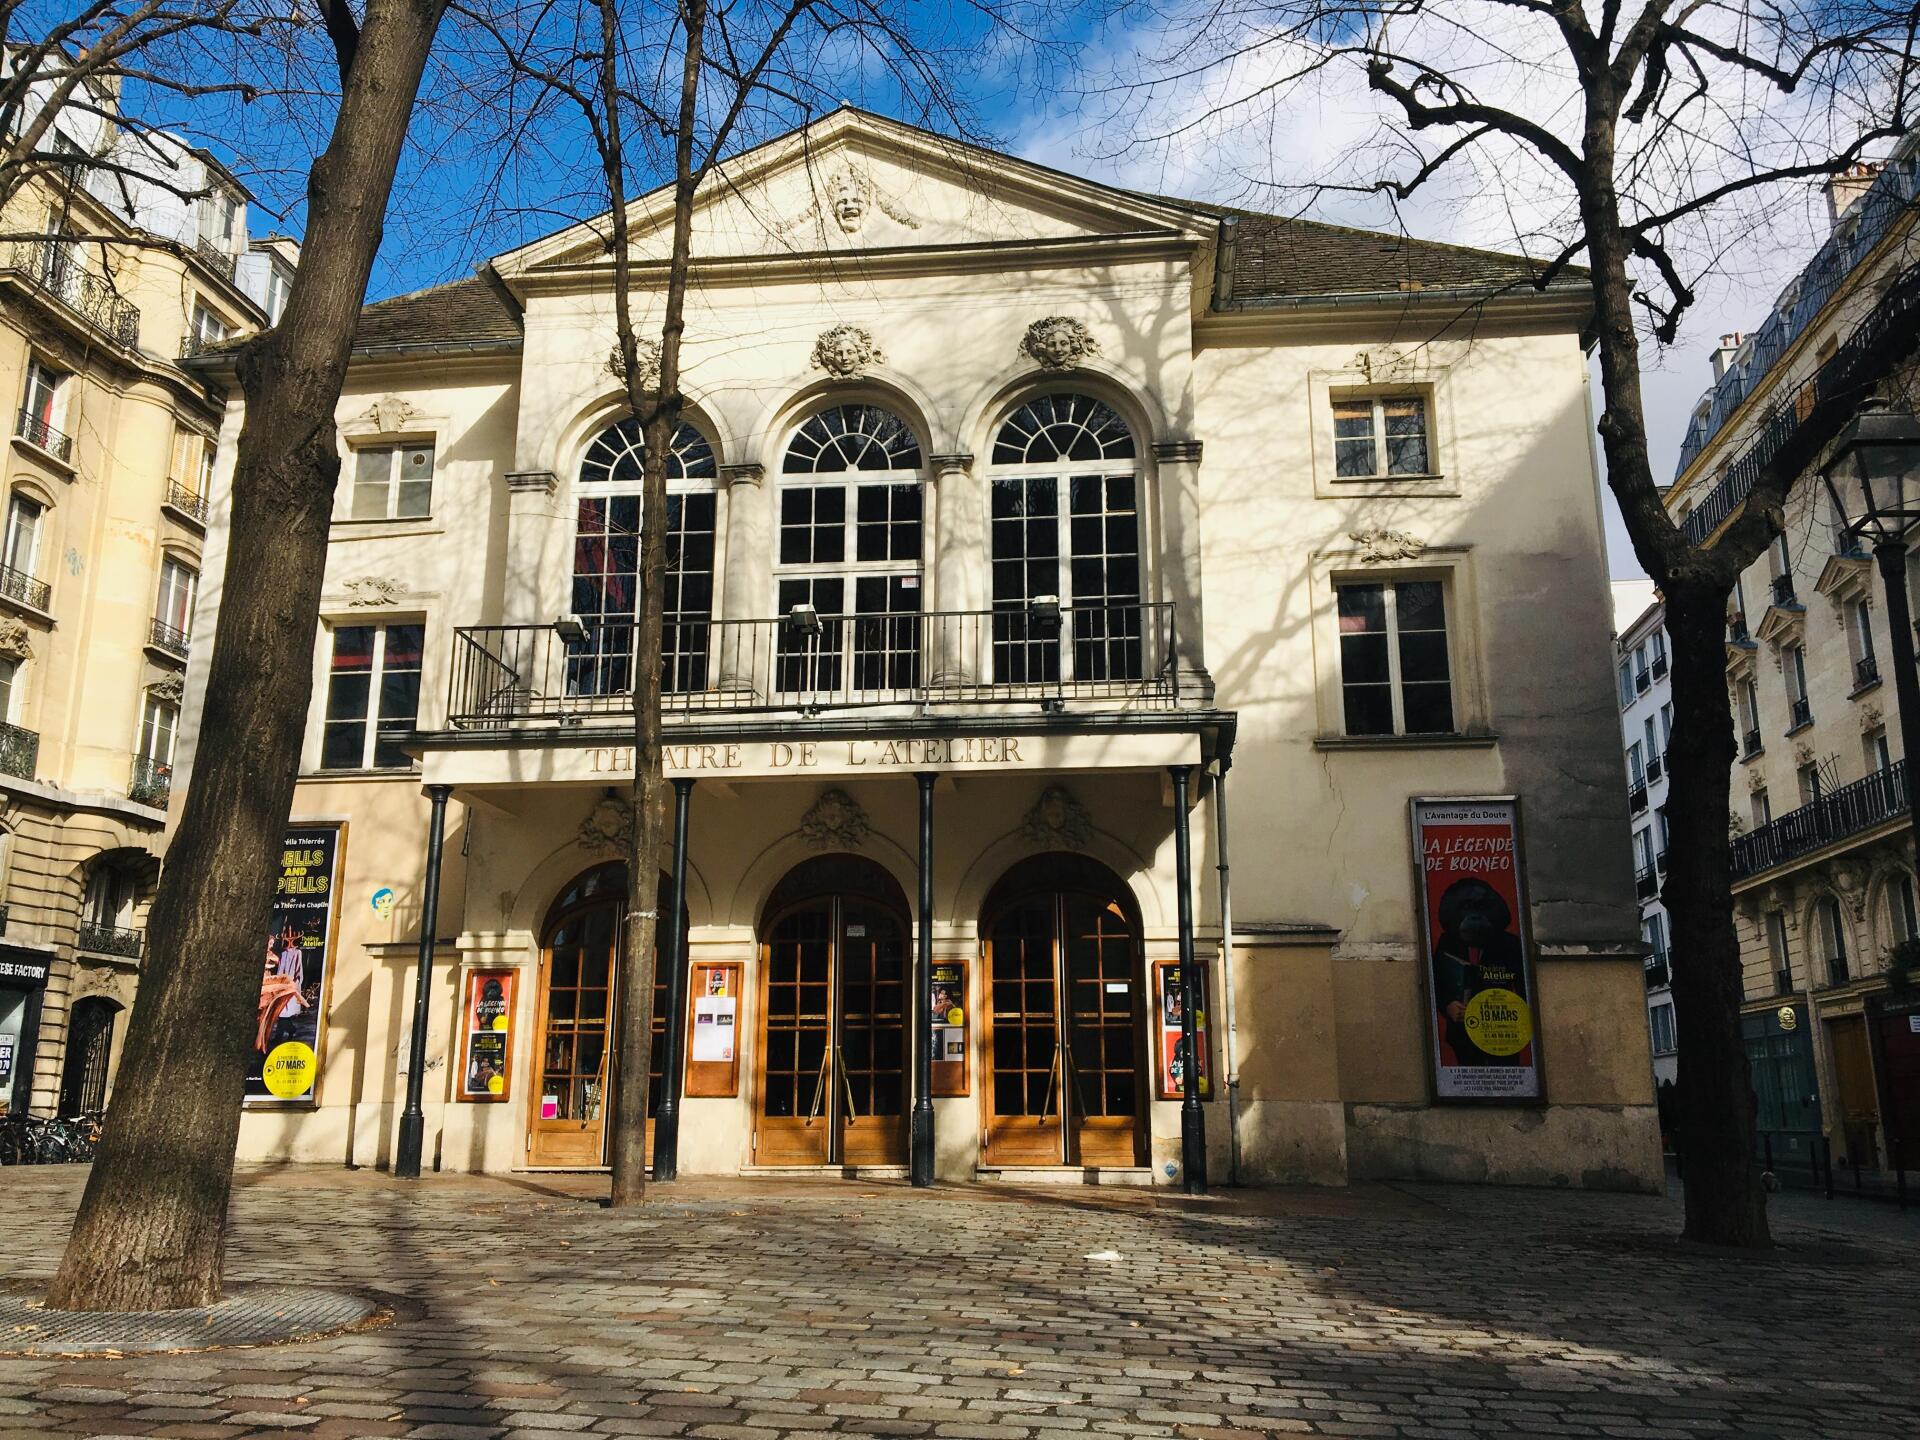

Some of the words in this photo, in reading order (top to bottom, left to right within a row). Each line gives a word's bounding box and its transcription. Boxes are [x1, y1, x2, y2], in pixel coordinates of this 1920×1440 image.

[586, 744, 742, 772] THATRE
[769, 748, 818, 768] DE
[847, 738, 1023, 765] L'ATELIER
[1425, 811, 1469, 820] L'Avantage
[1470, 811, 1481, 819] du
[1483, 811, 1507, 819] Doute
[284, 838, 298, 846] élia
[1423, 838, 1440, 855] LA
[1445, 834, 1513, 855] LÉGENDE
[281, 851, 324, 867] ELLS
[1426, 856, 1445, 872] DE
[1450, 853, 1509, 872] BORNÉO
[284, 867, 307, 877] AND
[276, 876, 328, 894] PELLS
[14, 964, 46, 979] FACTORY
[1482, 971, 1516, 981] Atelier
[1480, 1010, 1490, 1021] 19
[1492, 1010, 1518, 1021] MARS
[276, 1060, 285, 1070] 07
[286, 1060, 306, 1070] MARS
